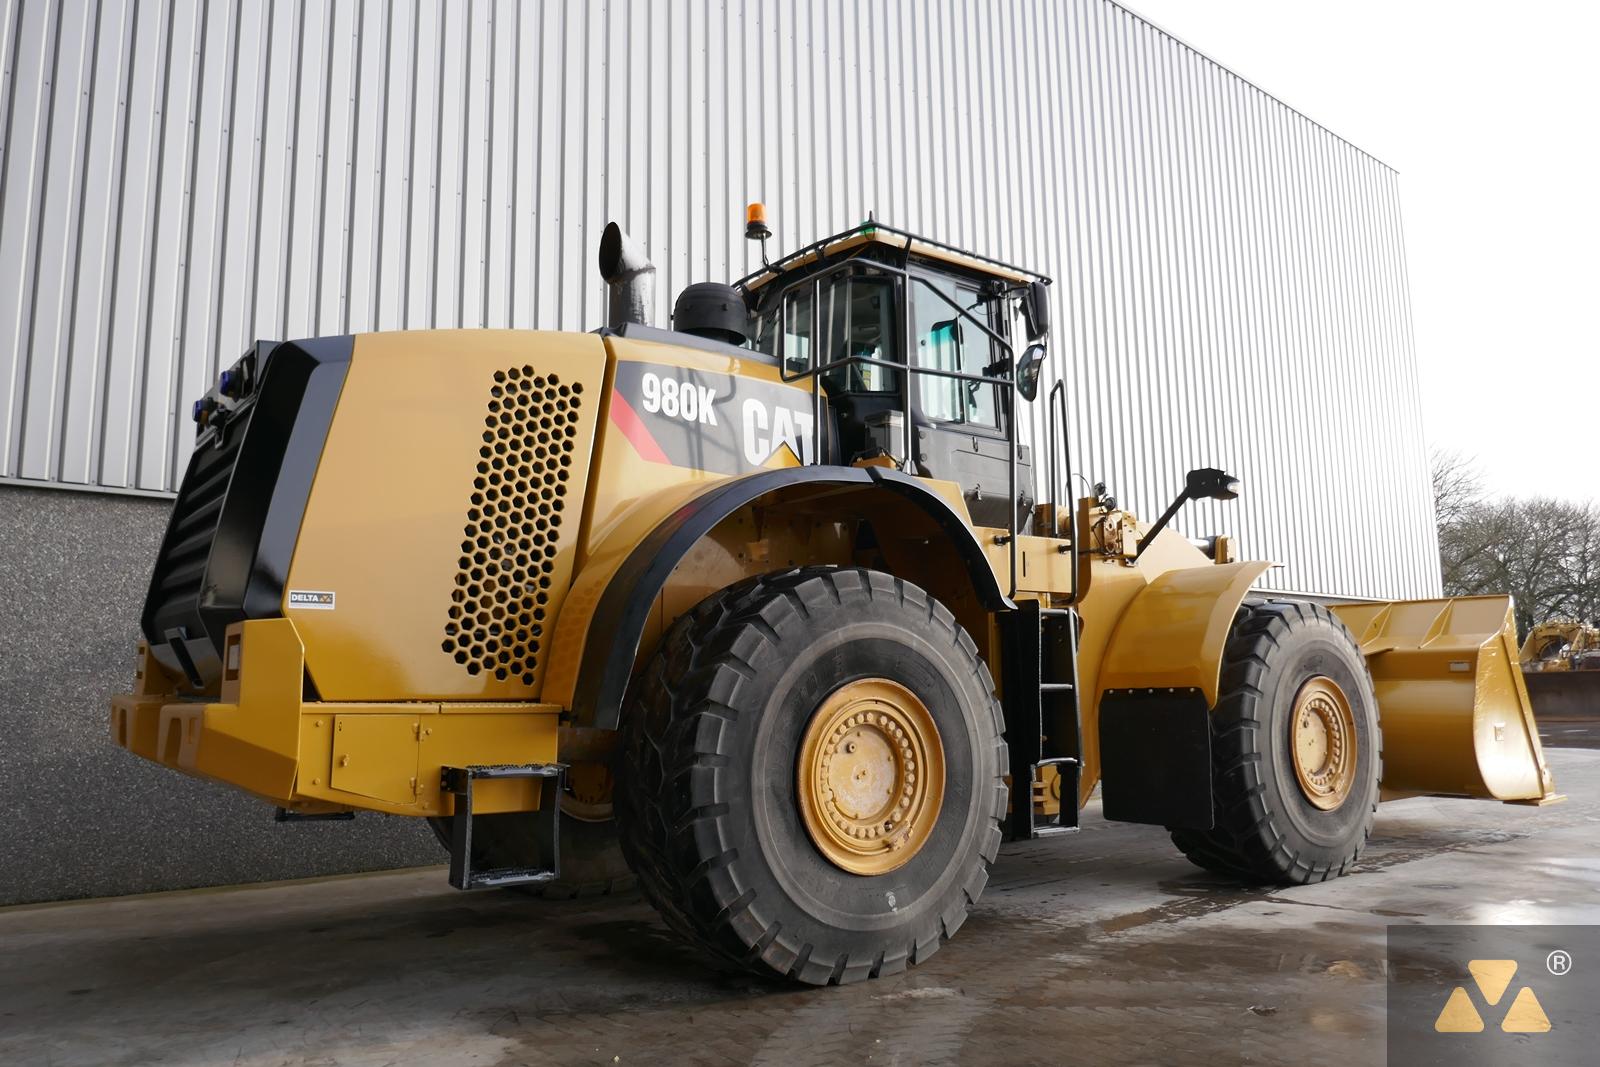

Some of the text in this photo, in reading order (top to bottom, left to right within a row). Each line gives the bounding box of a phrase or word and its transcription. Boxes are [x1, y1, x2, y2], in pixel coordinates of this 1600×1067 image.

[641, 372, 718, 426] 980K
[742, 398, 815, 467] CAT
[292, 594, 319, 602] DELTA
